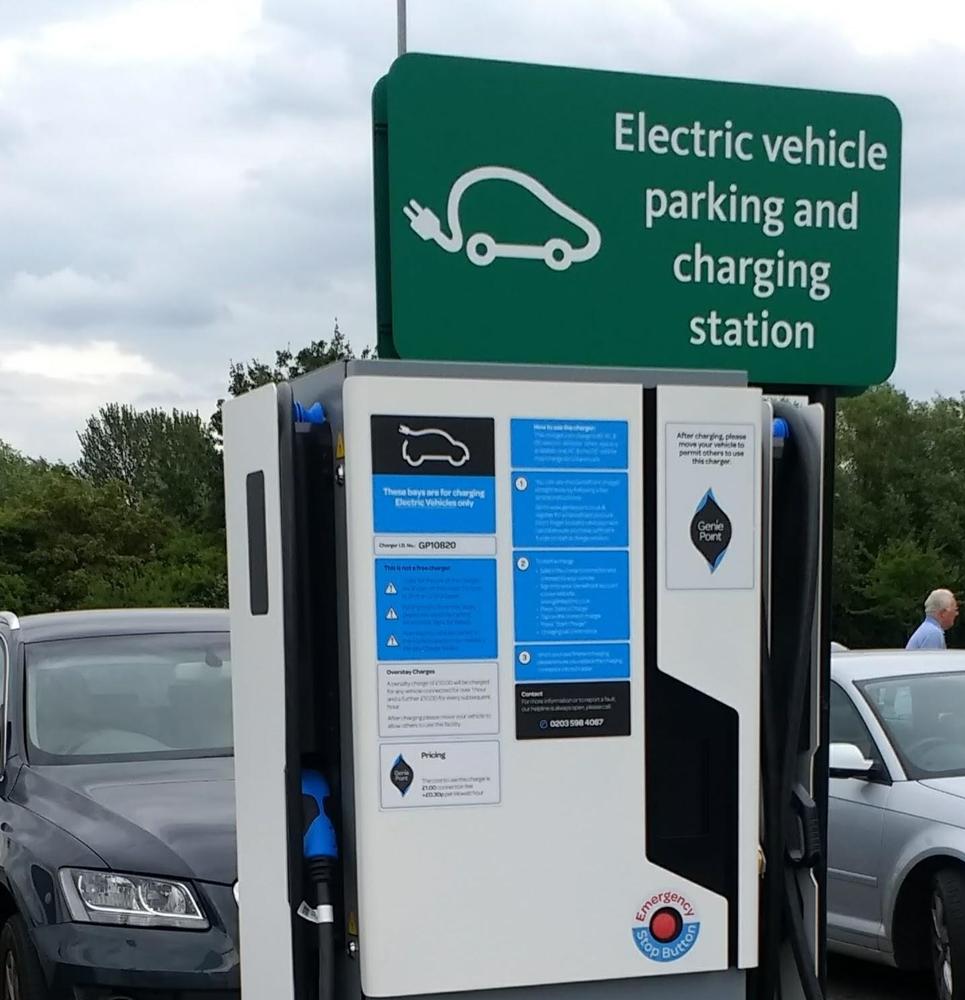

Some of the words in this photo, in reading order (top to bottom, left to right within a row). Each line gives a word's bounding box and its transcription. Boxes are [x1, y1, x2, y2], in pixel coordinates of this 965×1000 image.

[614, 111, 754, 162] Electric
[762, 126, 888, 172] vehicle
[645, 181, 785, 237] parking
[793, 191, 859, 231] and
[673, 243, 831, 301] charging
[689, 309, 814, 349] station
[676, 432, 694, 441] After
[695, 432, 724, 442] charging,
[725, 433, 747, 442] please
[698, 441, 713, 450] your
[713, 440, 737, 448] vehicle
[737, 441, 745, 449] to
[679, 449, 701, 458] permit
[702, 449, 724, 457] others
[724, 449, 732, 457] to
[692, 457, 704, 466] this
[383, 487, 406, 497] These
[407, 487, 425, 499] bays
[426, 489, 439, 497] are
[440, 488, 452, 496] for
[452, 488, 485, 498] charging
[395, 498, 424, 507] Electric
[425, 499, 456, 507] Vehicles
[457, 499, 474, 509] only
[697, 520, 724, 531] Genie
[699, 531, 722, 542] Point
[418, 541, 457, 550] GP10820
[550, 719, 570, 728] 0203
[421, 751, 446, 760] Pricing
[635, 891, 695, 922] Emergency
[637, 929, 660, 957] Stop
[662, 925, 697, 958] Button
